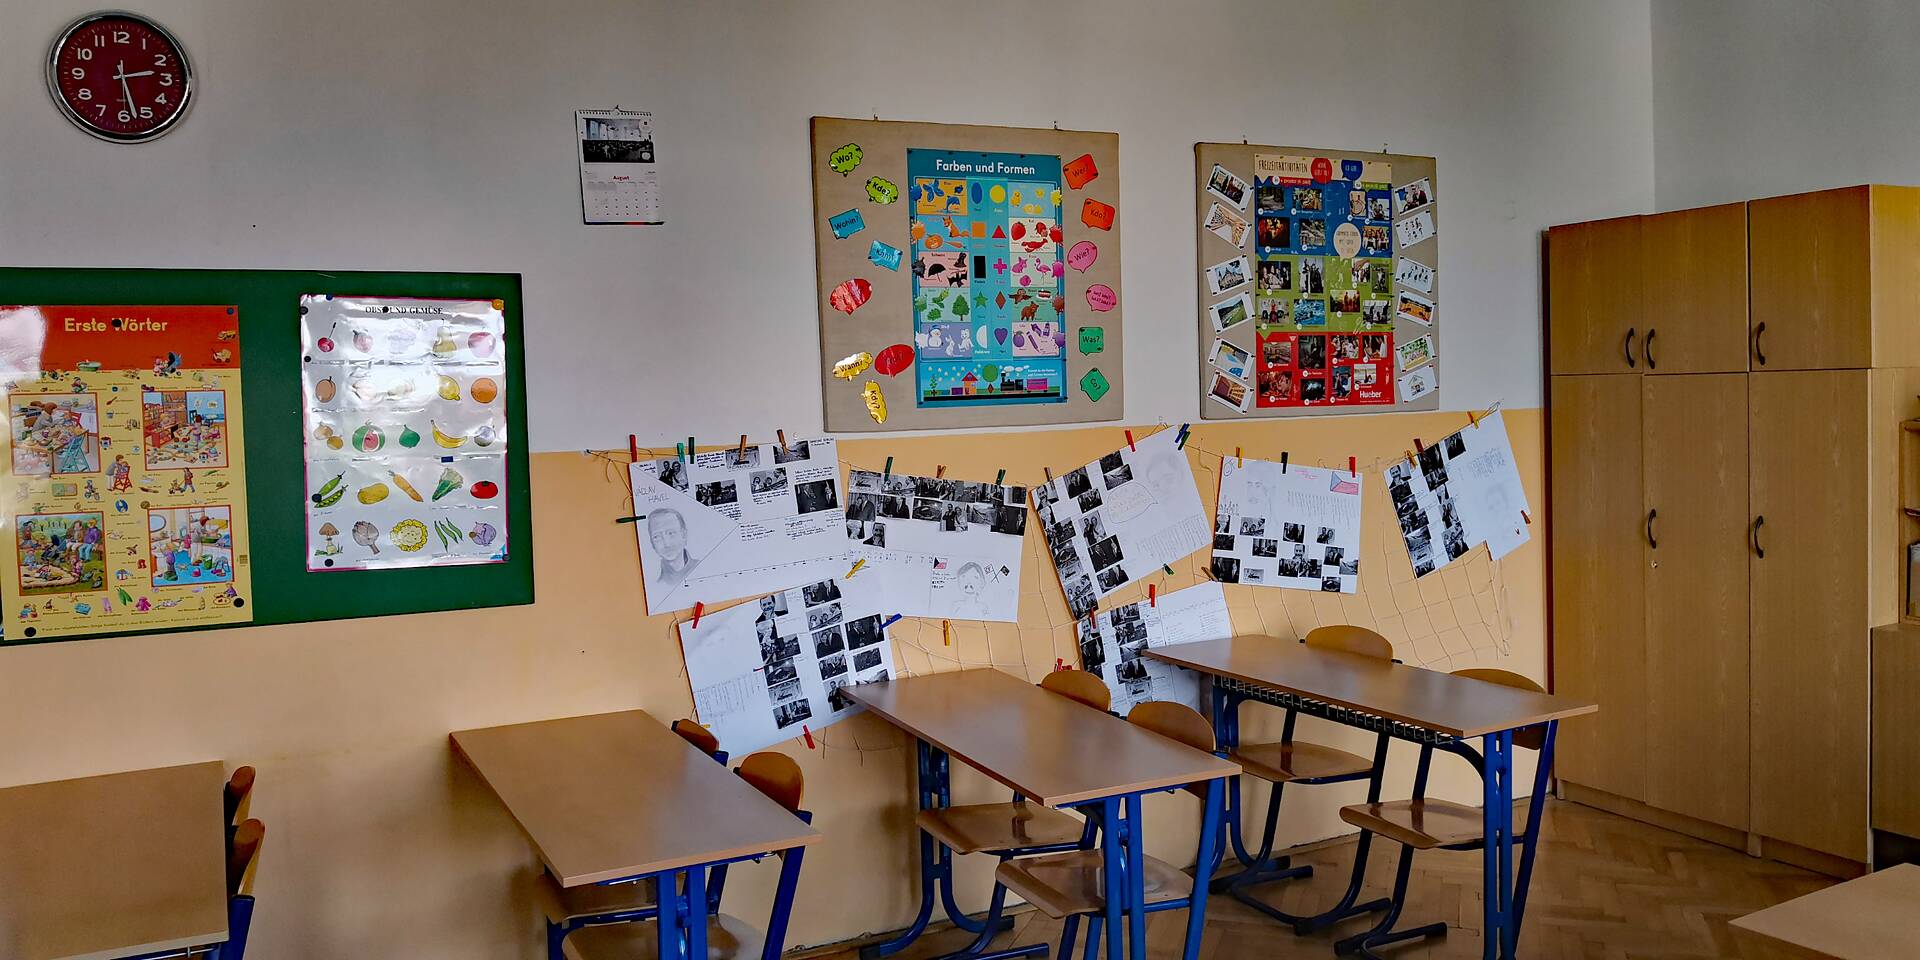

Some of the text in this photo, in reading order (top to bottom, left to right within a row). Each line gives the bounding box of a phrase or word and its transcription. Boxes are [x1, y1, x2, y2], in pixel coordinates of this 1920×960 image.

[94, 34, 105, 47] 11
[113, 31, 130, 44] 12
[142, 38, 146, 50] 1
[77, 48, 92, 60] 10
[154, 54, 167, 67] 2
[72, 67, 85, 80] 9
[159, 73, 173, 86] 3
[78, 88, 92, 100] 8
[155, 92, 167, 105] 4
[95, 104, 107, 117] 7
[117, 110, 130, 123] 6
[139, 107, 153, 119] 5
[836, 152, 854, 164] Wo?
[936, 159, 1035, 175] Farben und Formen
[1072, 164, 1089, 178] Wer?
[872, 182, 891, 196] Kde?
[1090, 209, 1107, 220] Kdo?
[834, 216, 859, 230] Wohin?
[1074, 248, 1090, 261] Wie?
[365, 306, 389, 314] OBS
[409, 305, 443, 314] GEMÜSE
[64, 317, 107, 332] Erste
[1082, 335, 1100, 343] Was?
[839, 359, 863, 373] Wann?
[870, 390, 880, 409] Kdy?
[1360, 390, 1382, 399] Hueber
